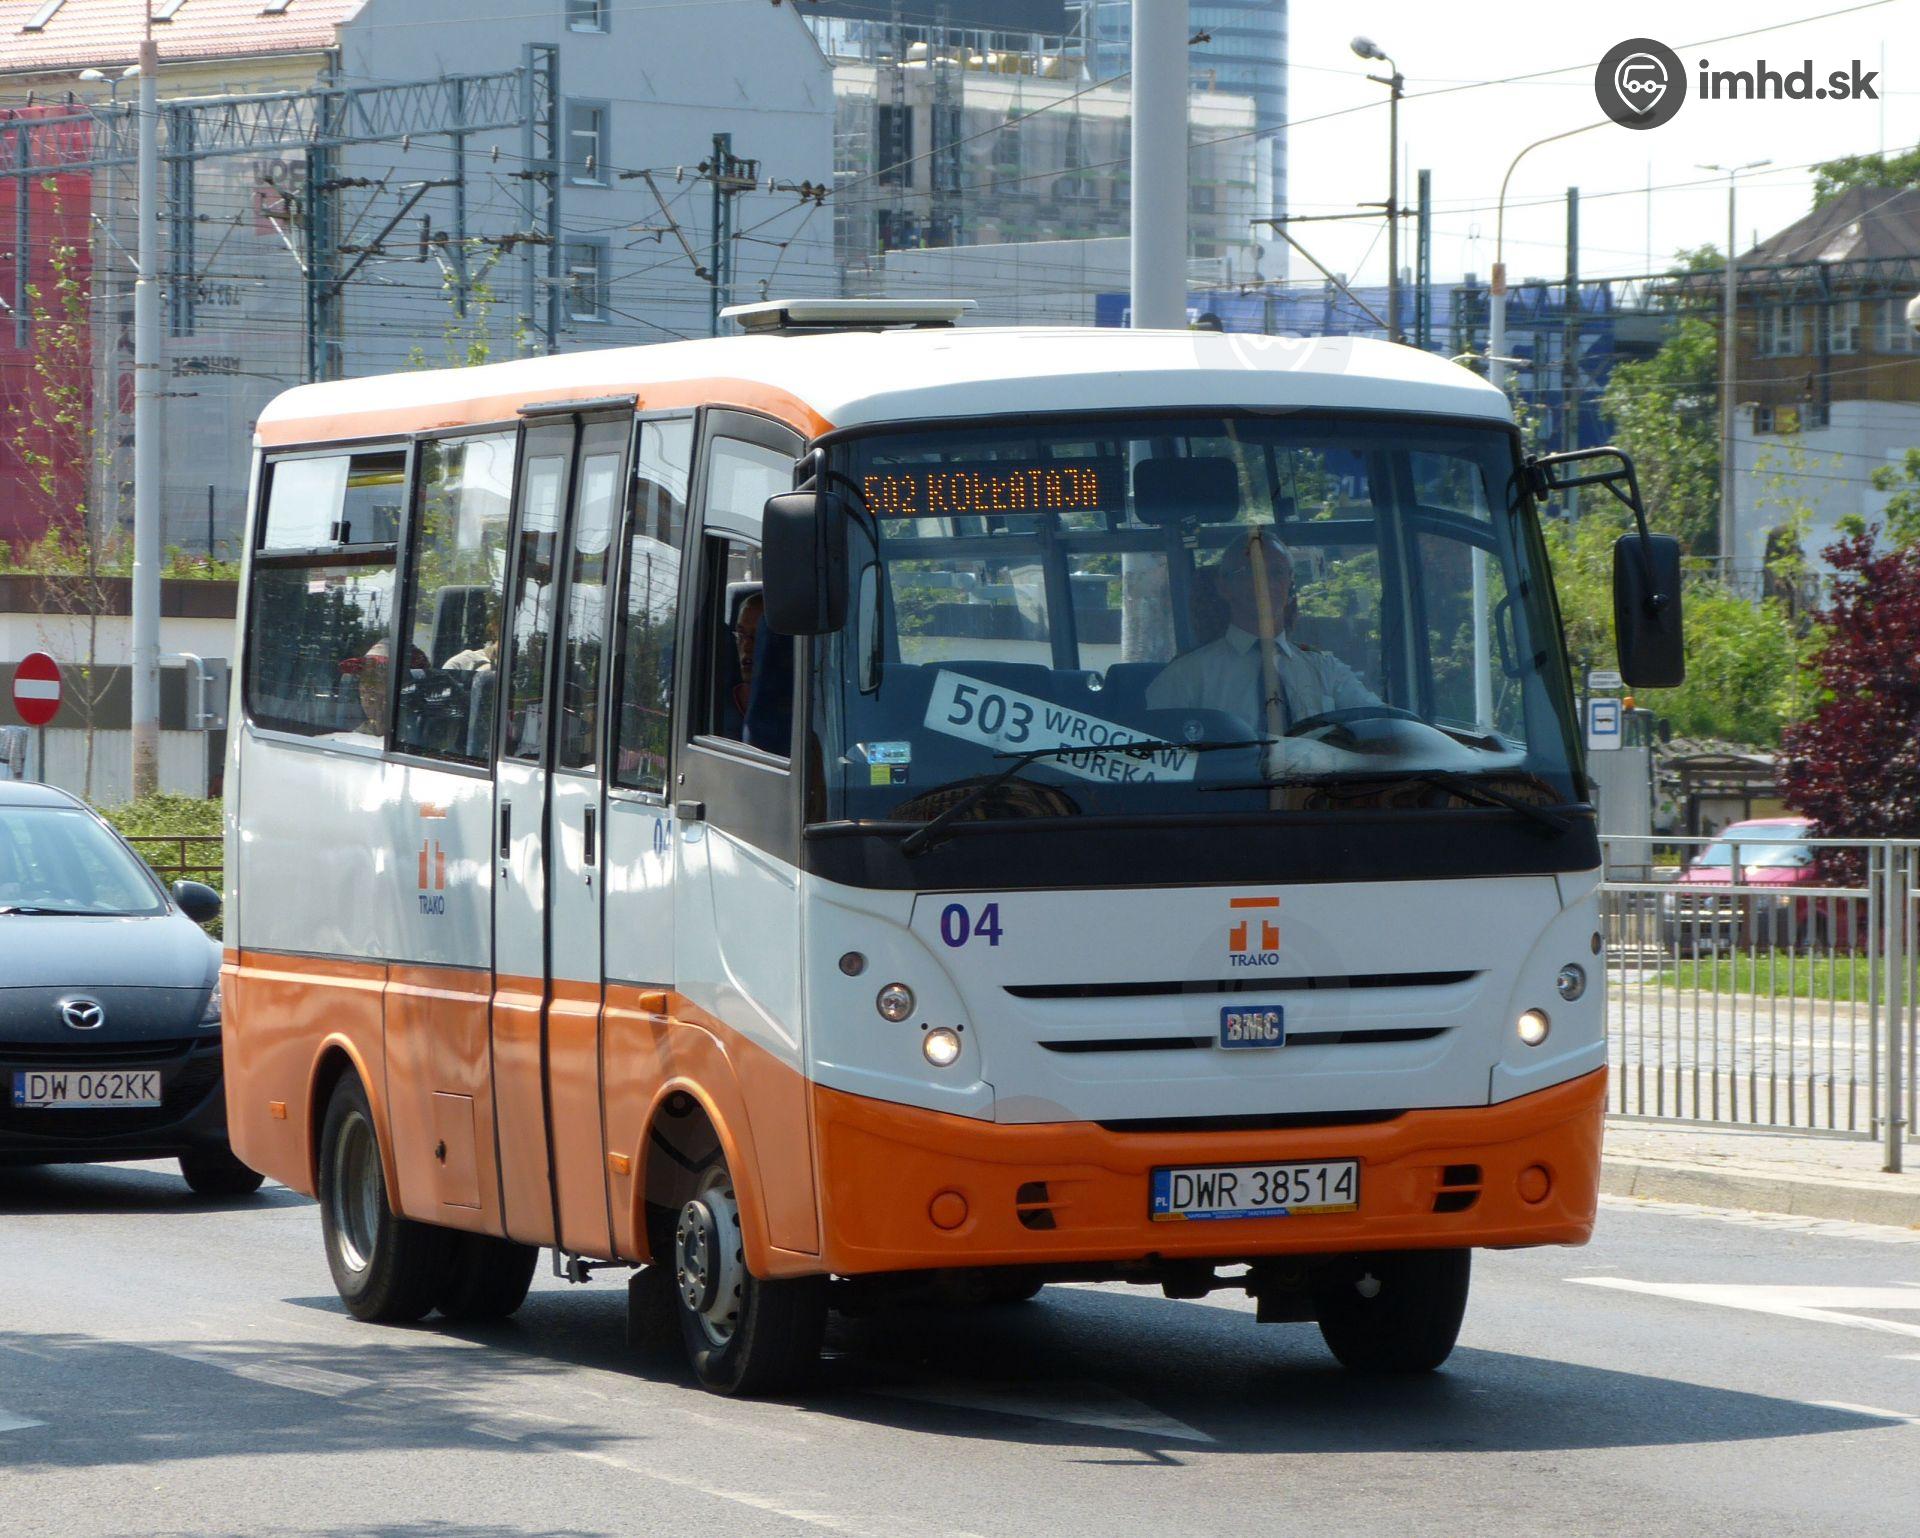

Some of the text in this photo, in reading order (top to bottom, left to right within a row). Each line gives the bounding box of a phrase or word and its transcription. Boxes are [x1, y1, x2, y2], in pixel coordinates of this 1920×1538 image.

[947, 683, 1034, 744] 503
[419, 895, 445, 915] TRAKO
[940, 902, 1003, 948] 04
[1229, 953, 1279, 966] TRAKO
[1227, 1012, 1279, 1041] BMC
[30, 1073, 156, 1100] DW 062KK
[1155, 1196, 1168, 1207] PL
[1172, 1166, 1353, 1209] DWR 38514
